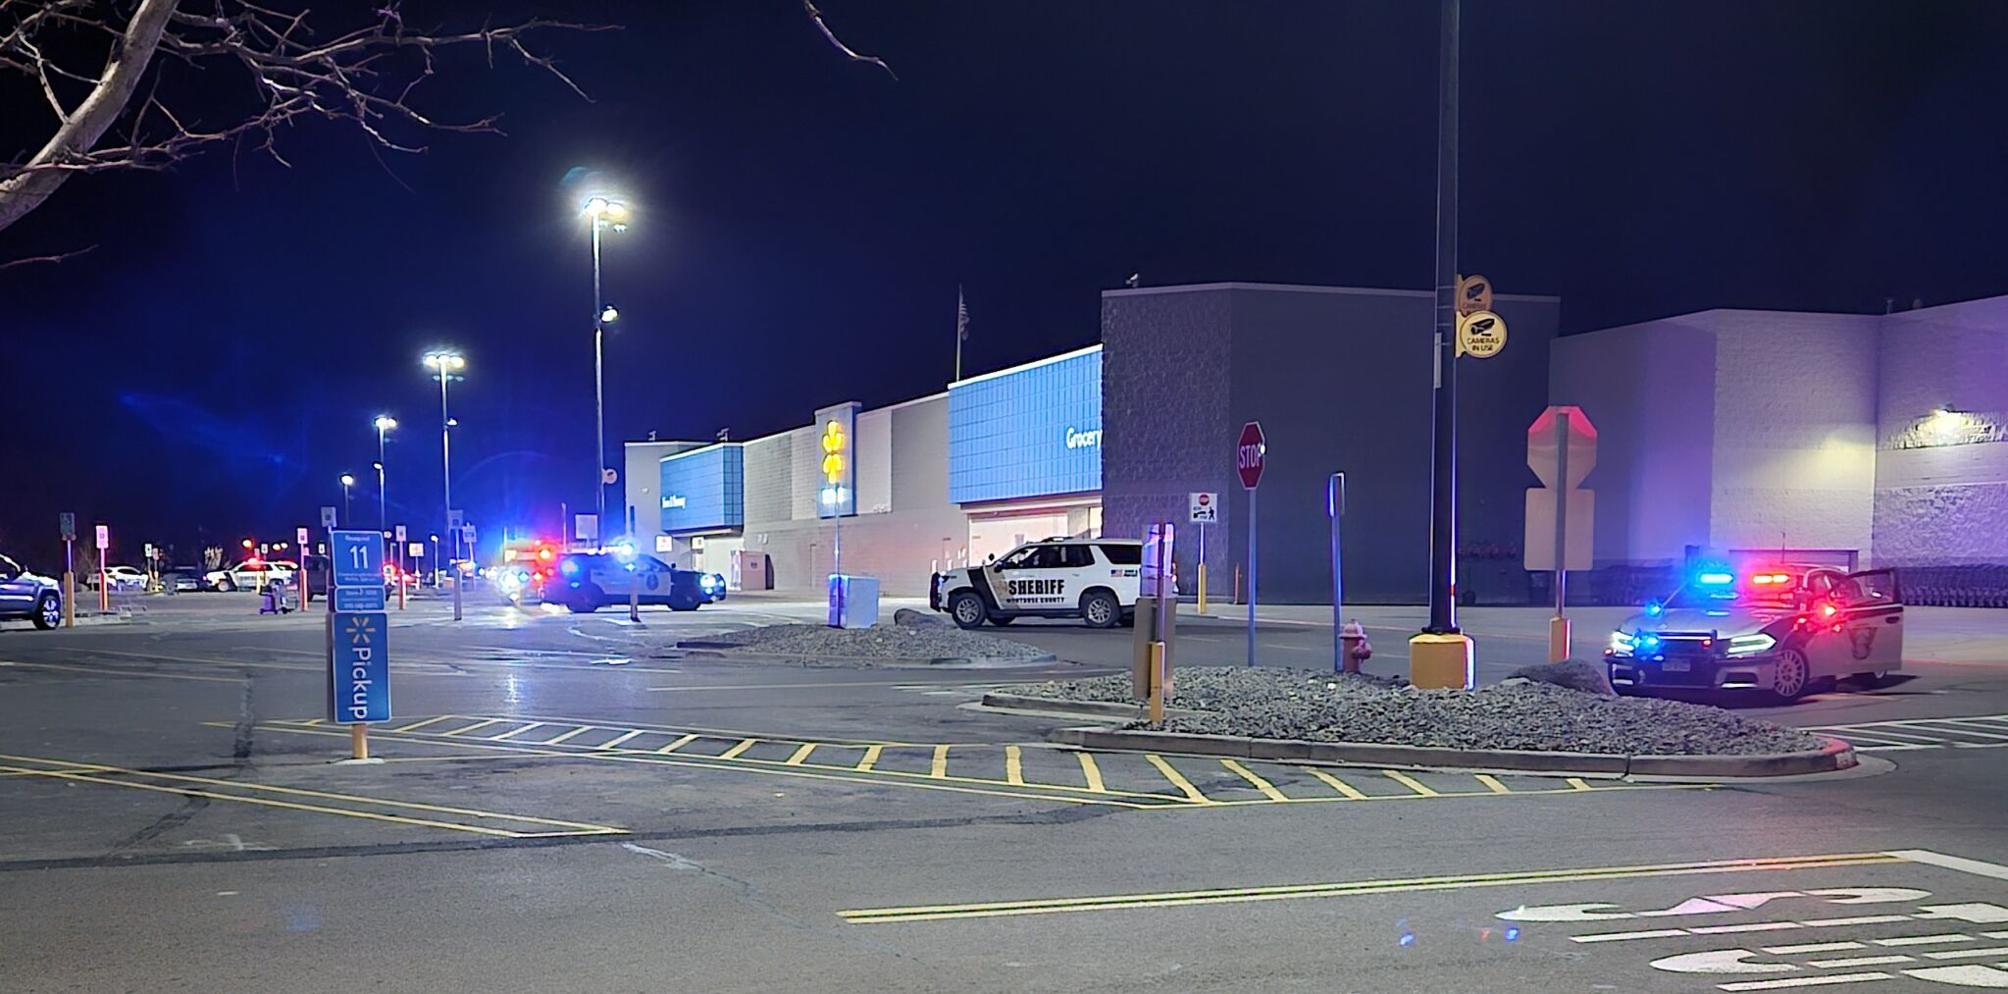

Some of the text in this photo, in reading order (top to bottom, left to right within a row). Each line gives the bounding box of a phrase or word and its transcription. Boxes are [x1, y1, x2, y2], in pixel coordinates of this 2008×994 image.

[1066, 427, 1103, 451] Grocery
[1239, 443, 1261, 469] STOP
[349, 545, 368, 569] 11
[1008, 579, 1065, 595] SHERIFF
[348, 647, 372, 719] Pickup
